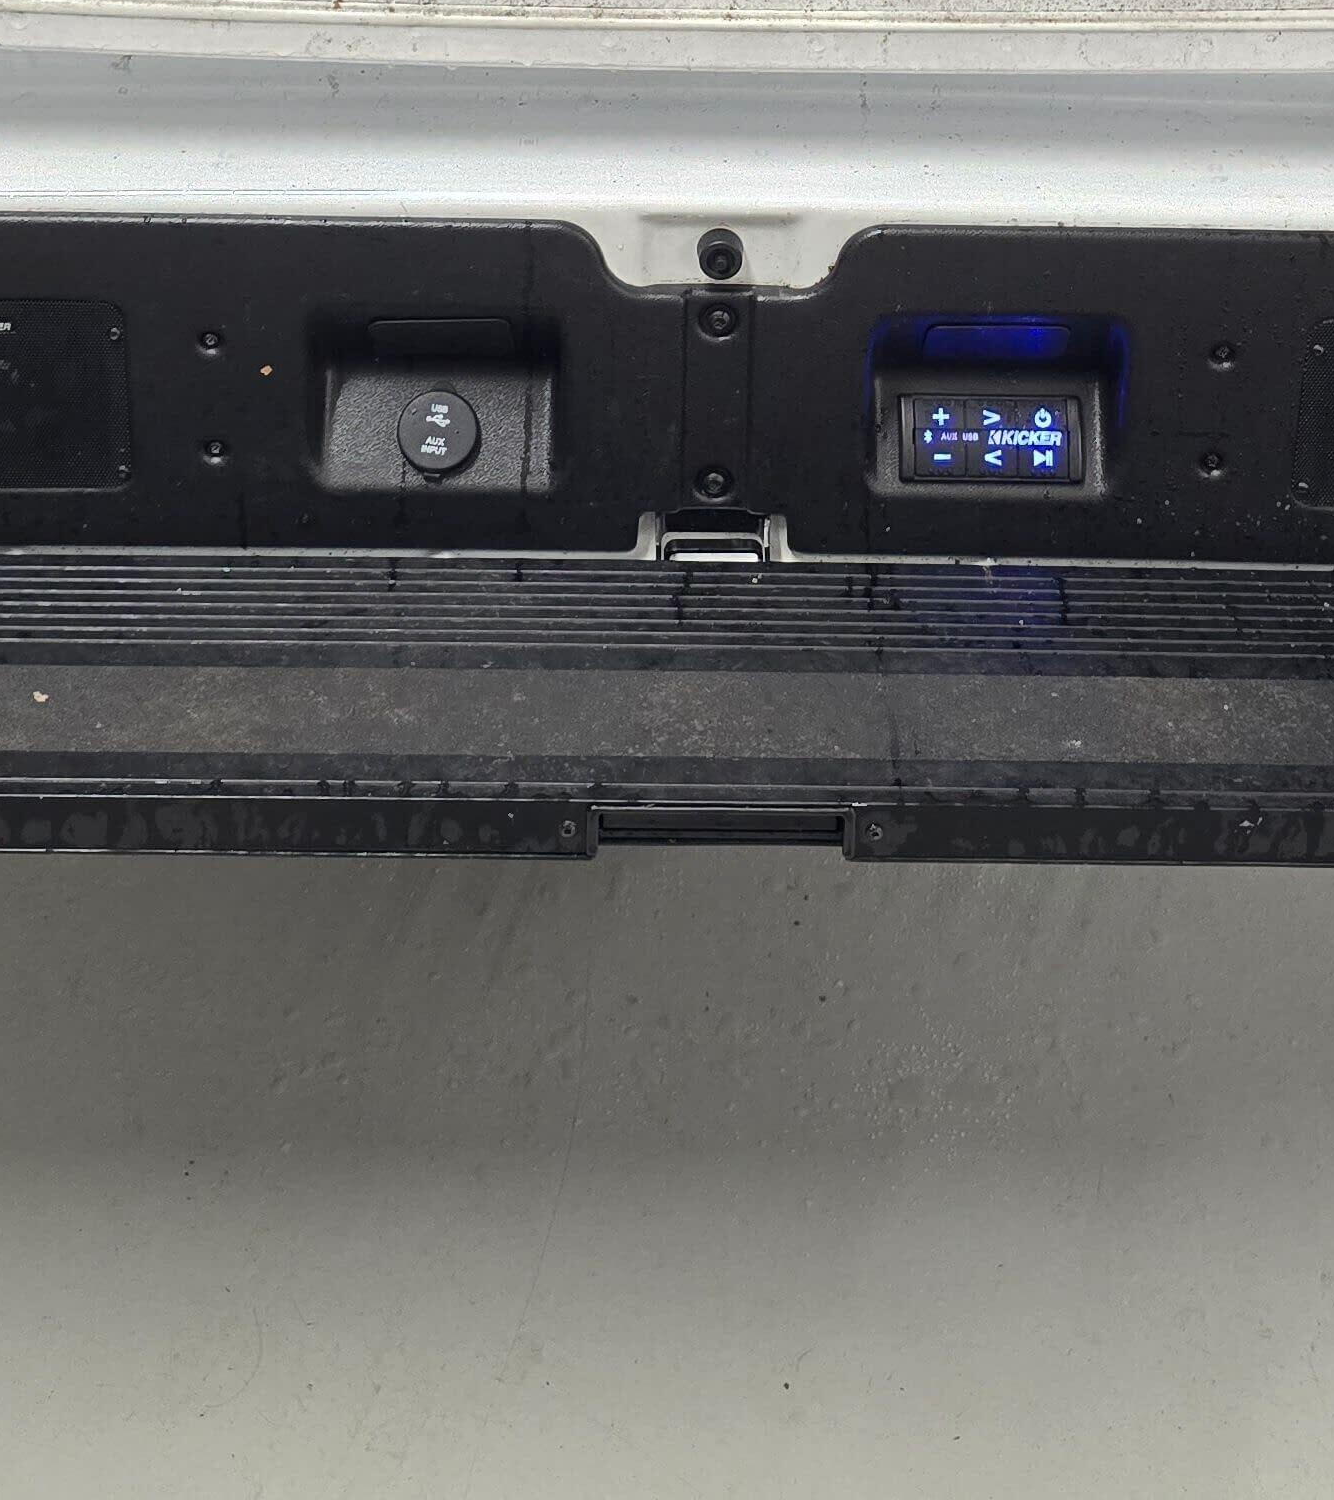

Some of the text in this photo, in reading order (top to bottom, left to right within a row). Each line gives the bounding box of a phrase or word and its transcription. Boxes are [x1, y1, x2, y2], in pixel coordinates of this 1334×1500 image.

[430, 403, 449, 414] USB
[425, 435, 446, 446] AUX
[940, 431, 979, 441] AUX USB
[1000, 430, 1063, 446] KICKER
[420, 444, 448, 456] INPUT
